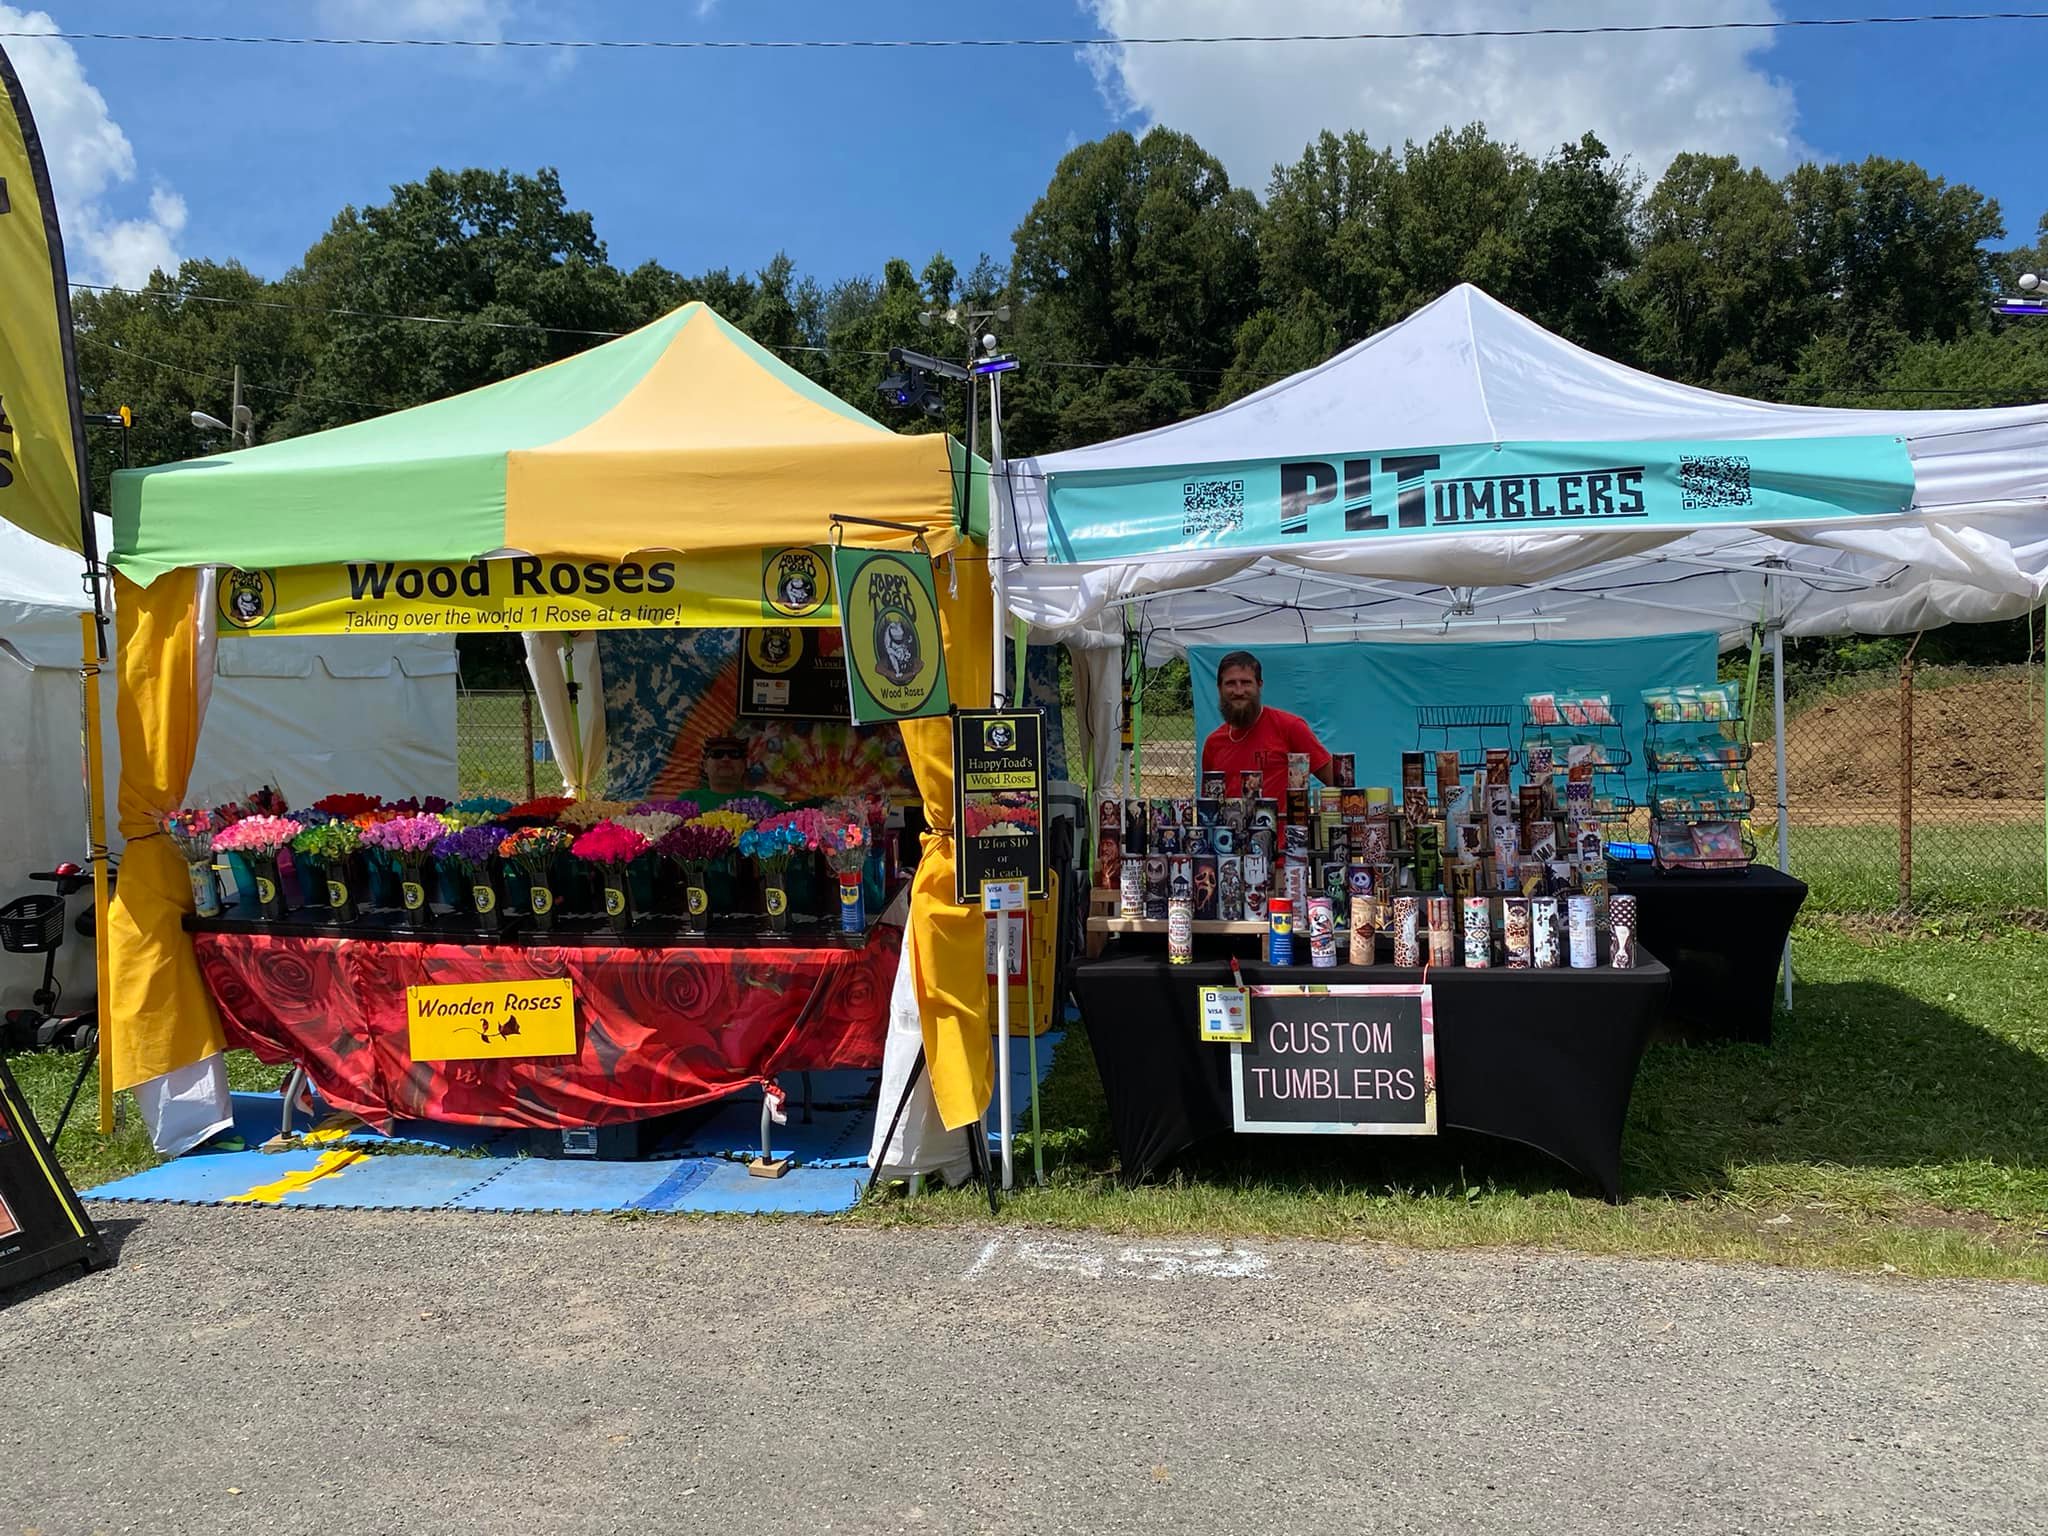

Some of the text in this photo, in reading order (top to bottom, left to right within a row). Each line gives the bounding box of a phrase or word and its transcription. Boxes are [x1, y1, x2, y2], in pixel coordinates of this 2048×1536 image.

[347, 555, 676, 600] Wood Roses
[345, 603, 682, 631] Taking over the world 1 Rose at a time!
[880, 686, 925, 699] Wood Roses
[971, 773, 1032, 785] Wood Roses
[978, 837, 1029, 849] 12 for $10
[997, 855, 1009, 863] or
[984, 866, 1023, 878] $1 each
[987, 885, 1002, 893] VISA
[1217, 992, 1244, 1002] Square
[418, 993, 563, 1018] Wooden Roses
[1269, 1022, 1392, 1054] CUSTOM
[1251, 1068, 1416, 1101] TUMBLERS
